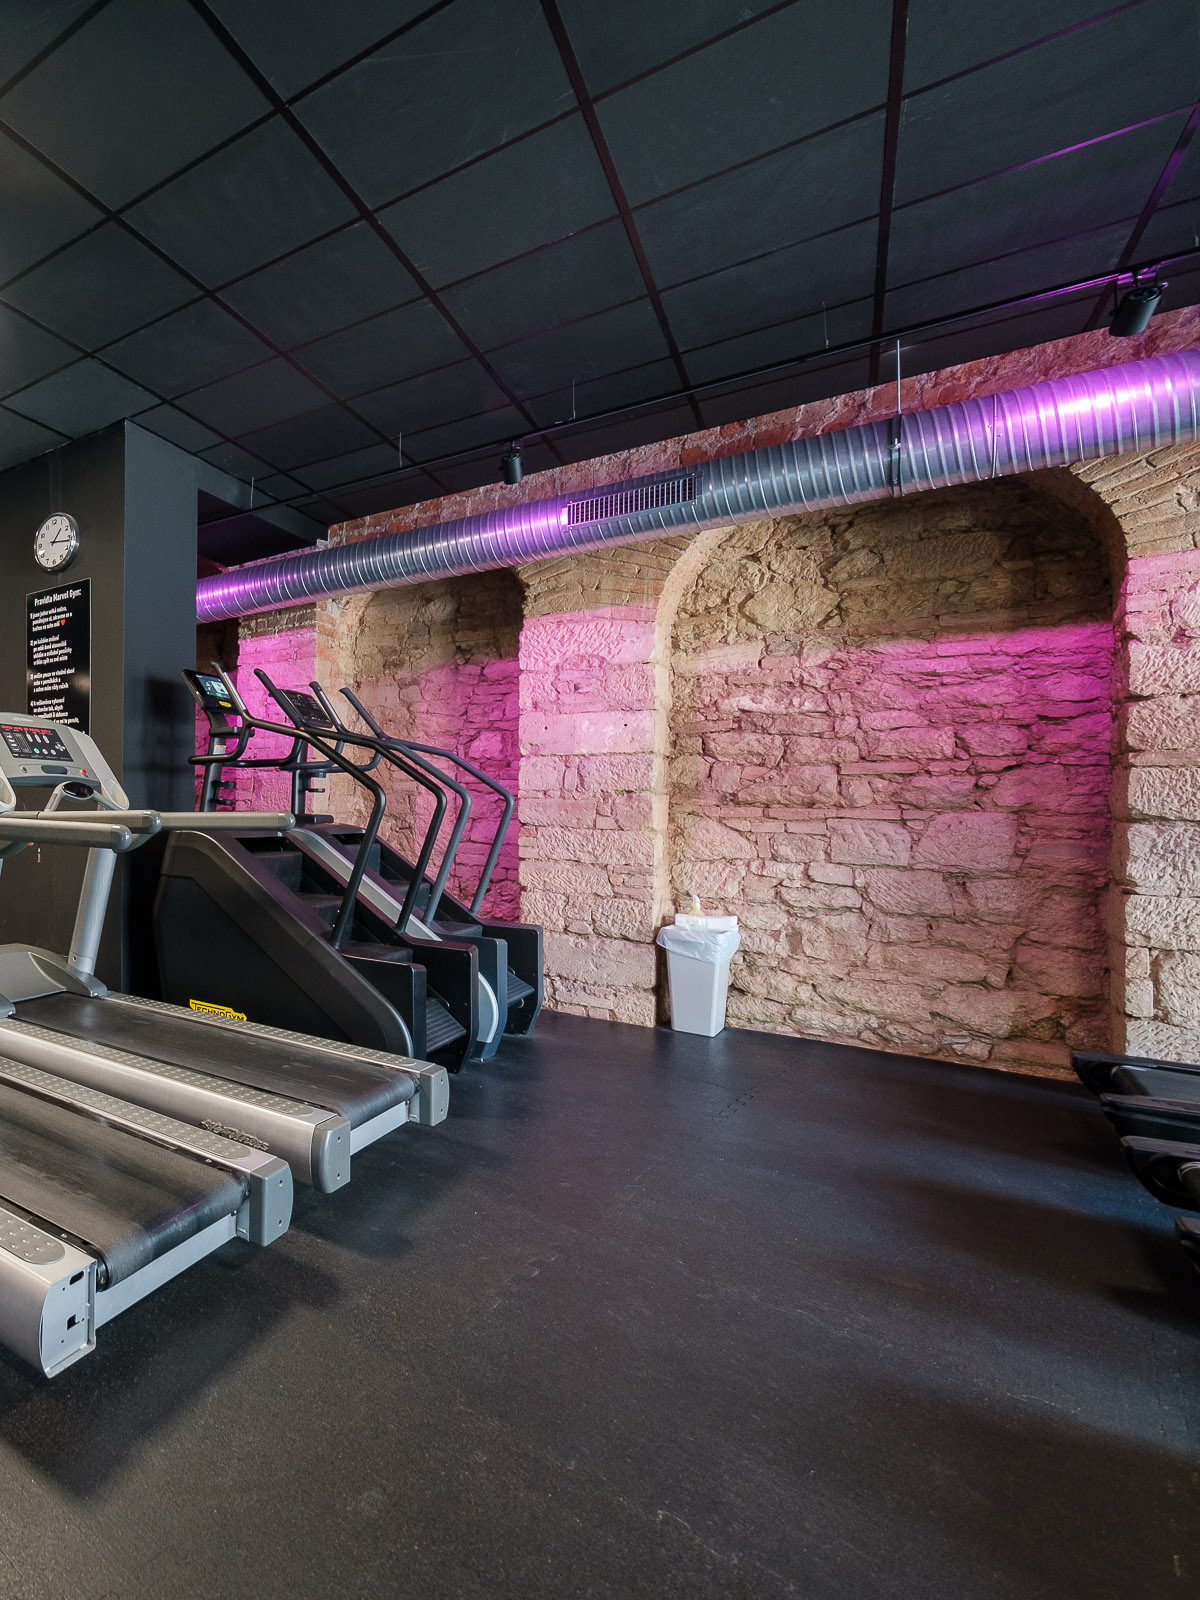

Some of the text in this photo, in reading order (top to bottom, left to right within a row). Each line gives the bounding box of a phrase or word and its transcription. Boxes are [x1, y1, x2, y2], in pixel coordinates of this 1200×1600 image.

[34, 589, 82, 606] Pravidla Marvel Gym:
